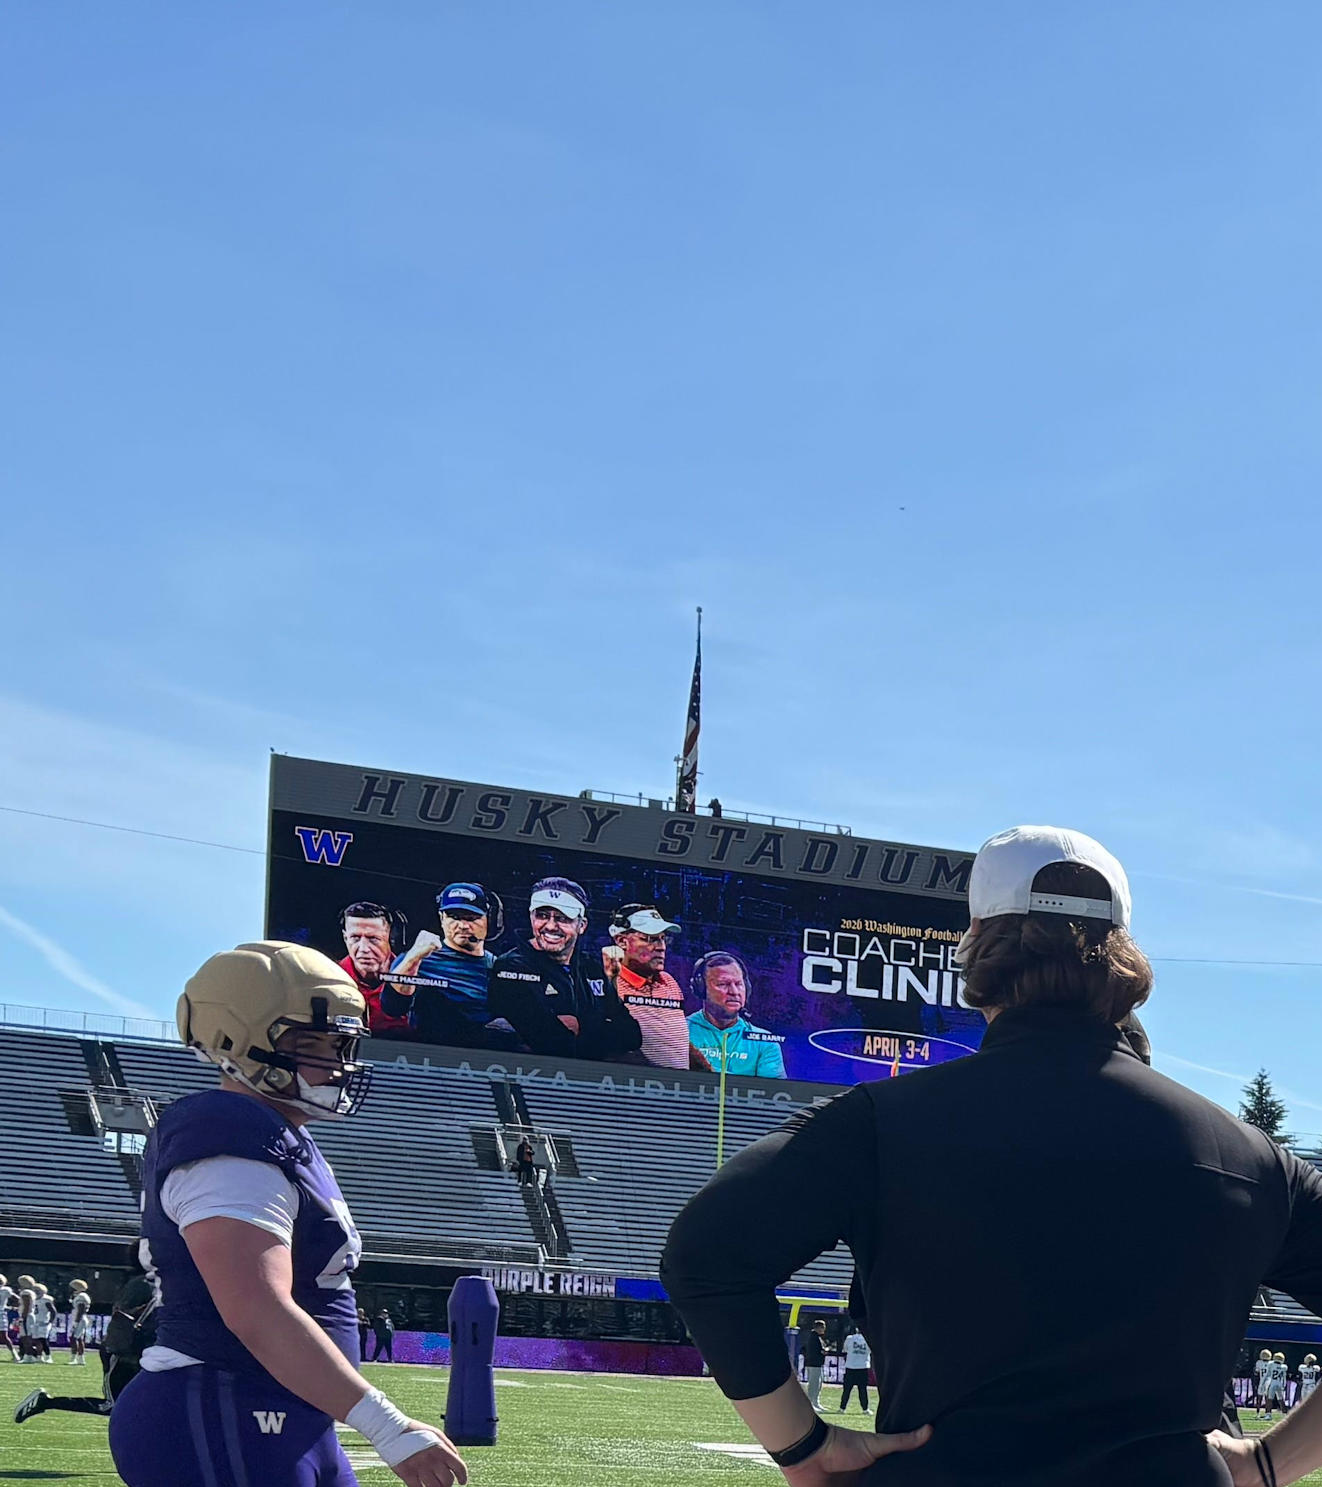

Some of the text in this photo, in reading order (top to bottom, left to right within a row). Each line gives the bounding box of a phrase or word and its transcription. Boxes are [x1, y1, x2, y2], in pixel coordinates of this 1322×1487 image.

[295, 826, 353, 866] W
[353, 773, 974, 895] HUSKY STADIUM
[841, 918, 863, 930] 2026
[864, 920, 923, 938] Washington
[803, 928, 963, 972] COACHE
[379, 974, 449, 988] MIKE MACDONALD
[497, 971, 540, 982] JEDD FISCH
[628, 996, 681, 1009] GUS MALZAHN
[761, 1034, 786, 1042] BARRY
[863, 1034, 930, 1061] APRIL 3-4
[559, 1272, 616, 1298] REIGN
[252, 1410, 287, 1435] W
